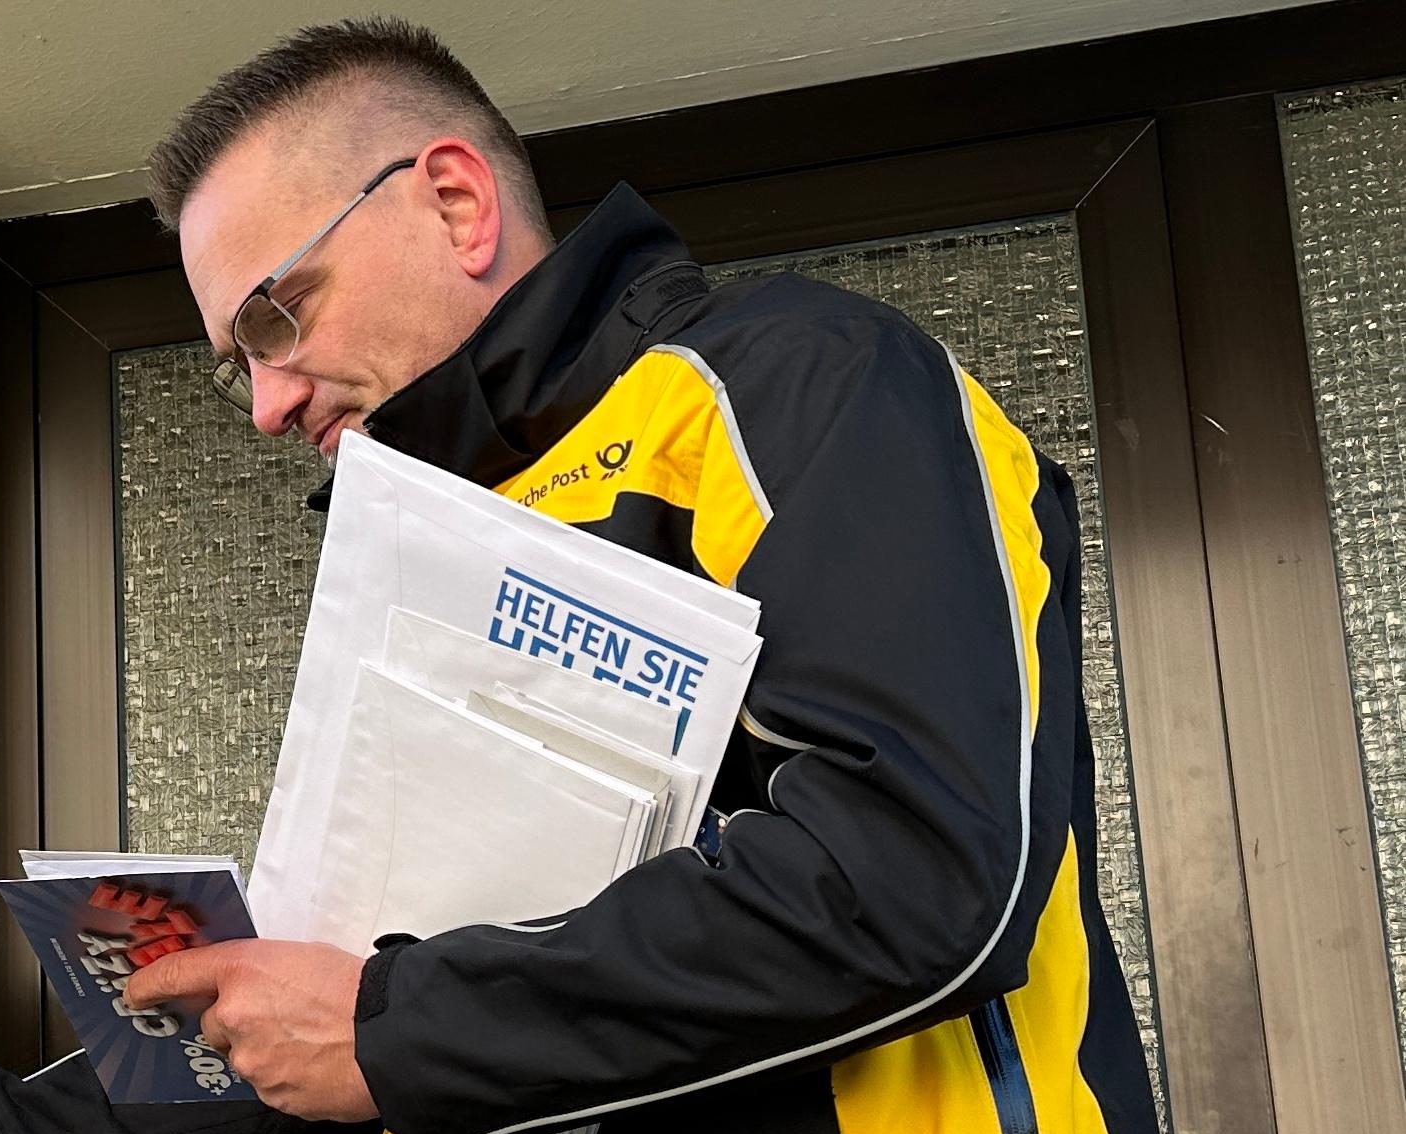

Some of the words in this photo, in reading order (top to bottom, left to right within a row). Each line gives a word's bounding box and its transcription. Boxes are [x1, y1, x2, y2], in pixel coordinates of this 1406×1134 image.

[551, 463, 590, 491] Post
[495, 580, 631, 670] HELFEN
[637, 650, 704, 703] SIE
